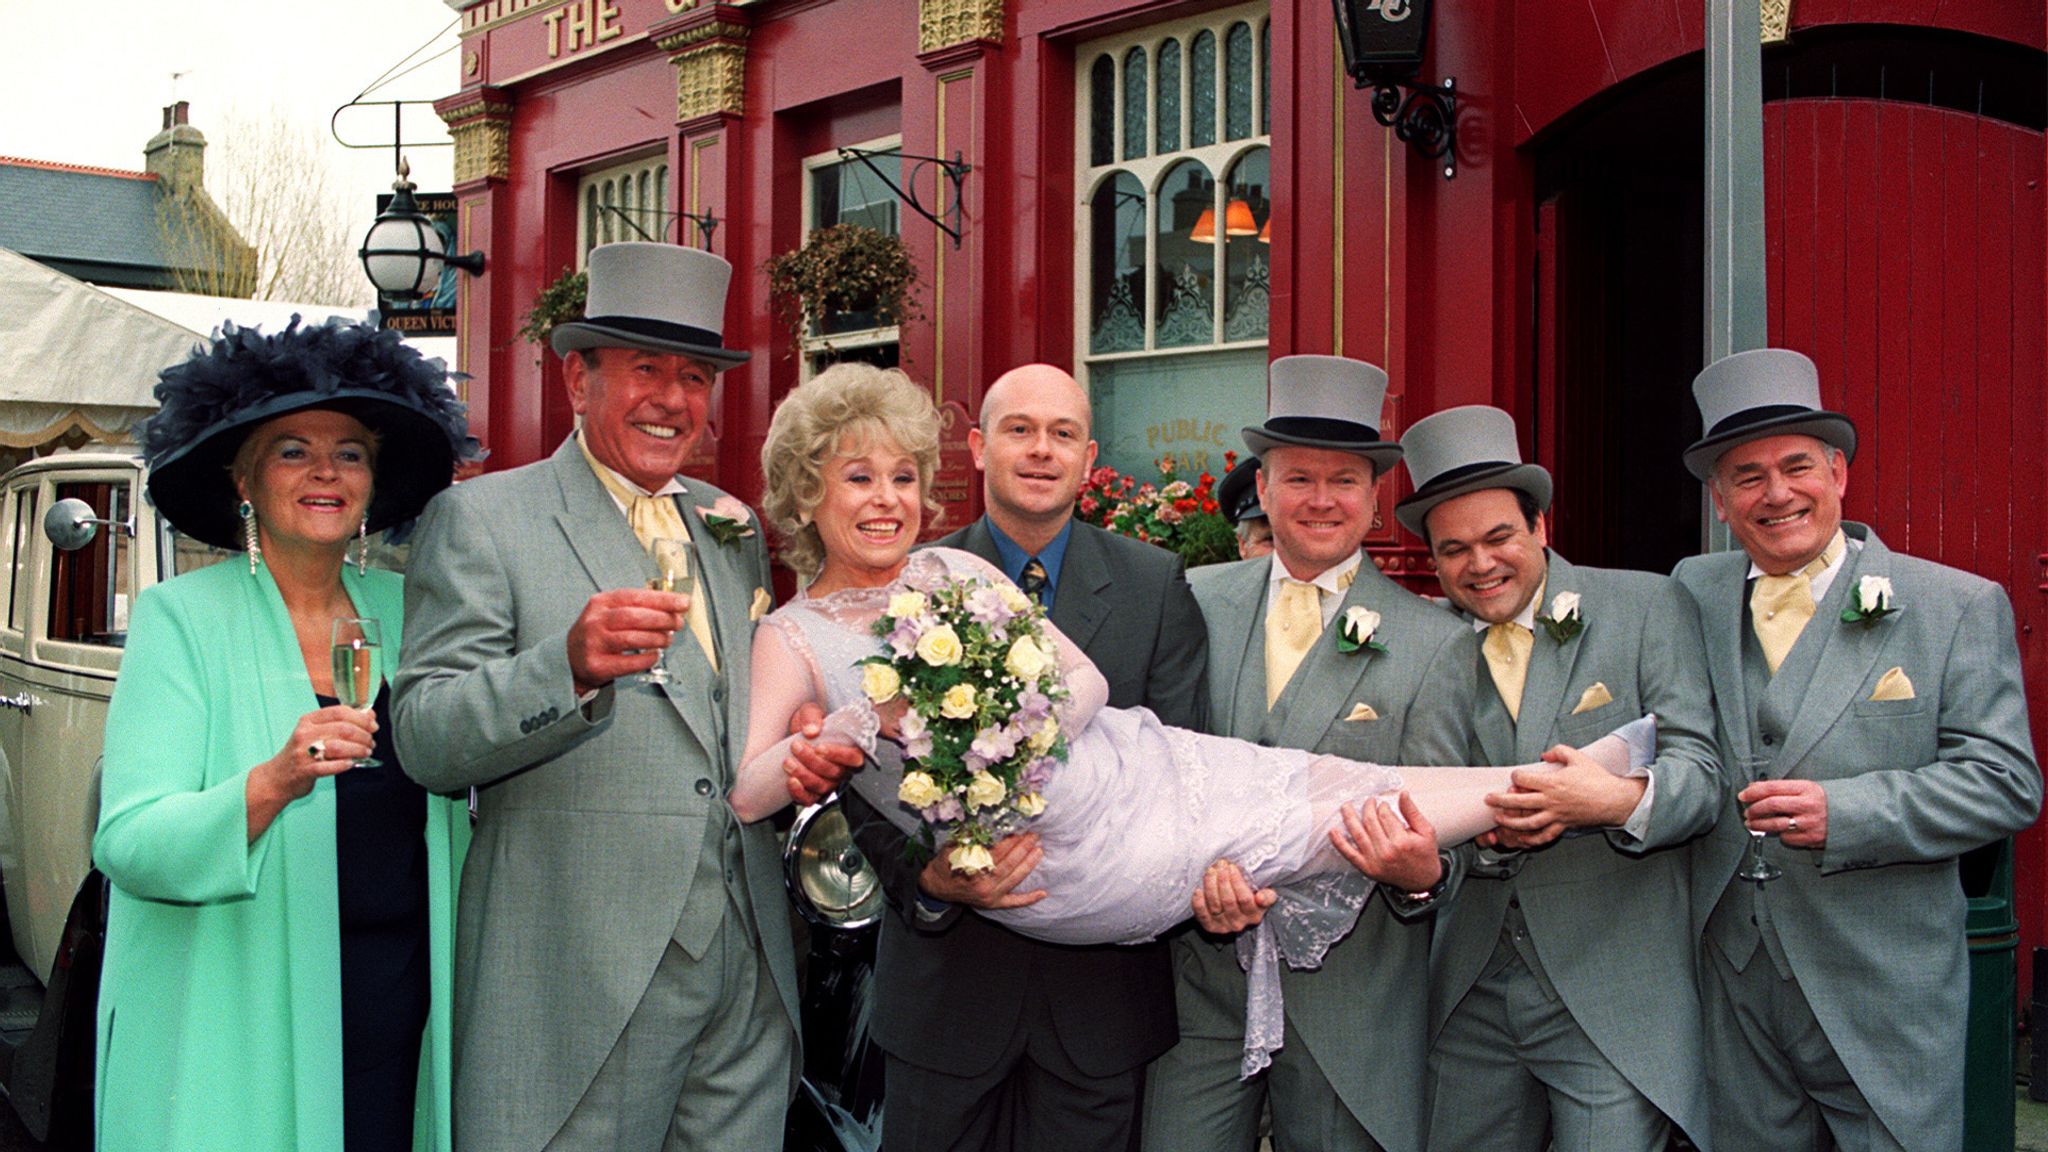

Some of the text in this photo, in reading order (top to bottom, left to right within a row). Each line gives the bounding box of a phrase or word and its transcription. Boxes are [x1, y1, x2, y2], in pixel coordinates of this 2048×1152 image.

[542, 0, 622, 58] THE
[387, 316, 427, 330] QUEEN
[1146, 417, 1227, 450] PUBLIC
